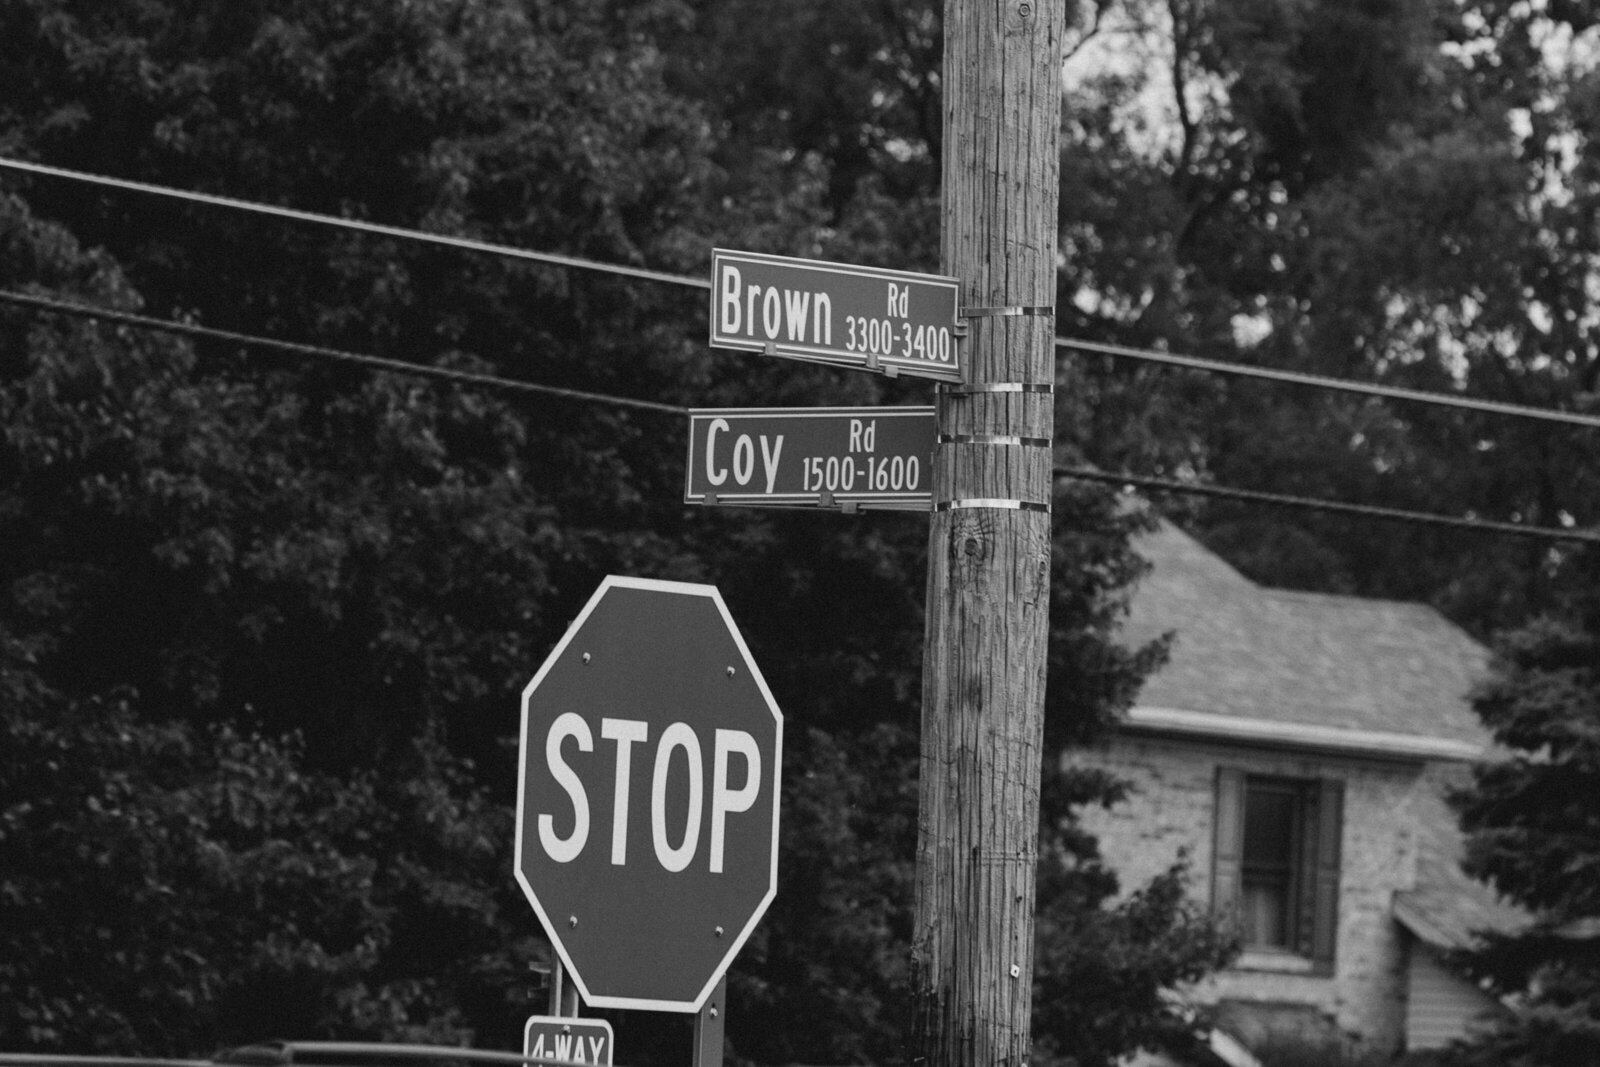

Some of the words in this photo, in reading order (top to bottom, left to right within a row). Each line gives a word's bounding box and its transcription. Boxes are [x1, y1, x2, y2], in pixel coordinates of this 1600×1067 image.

[721, 265, 832, 345] Brown
[887, 282, 909, 319] Rd
[845, 315, 950, 362] 3300-3400
[706, 418, 784, 494] Coy
[849, 419, 876, 453] Rd
[803, 455, 920, 491] 1500-1600
[537, 711, 762, 874] STOP
[531, 1033, 605, 1066] 4-WAY
